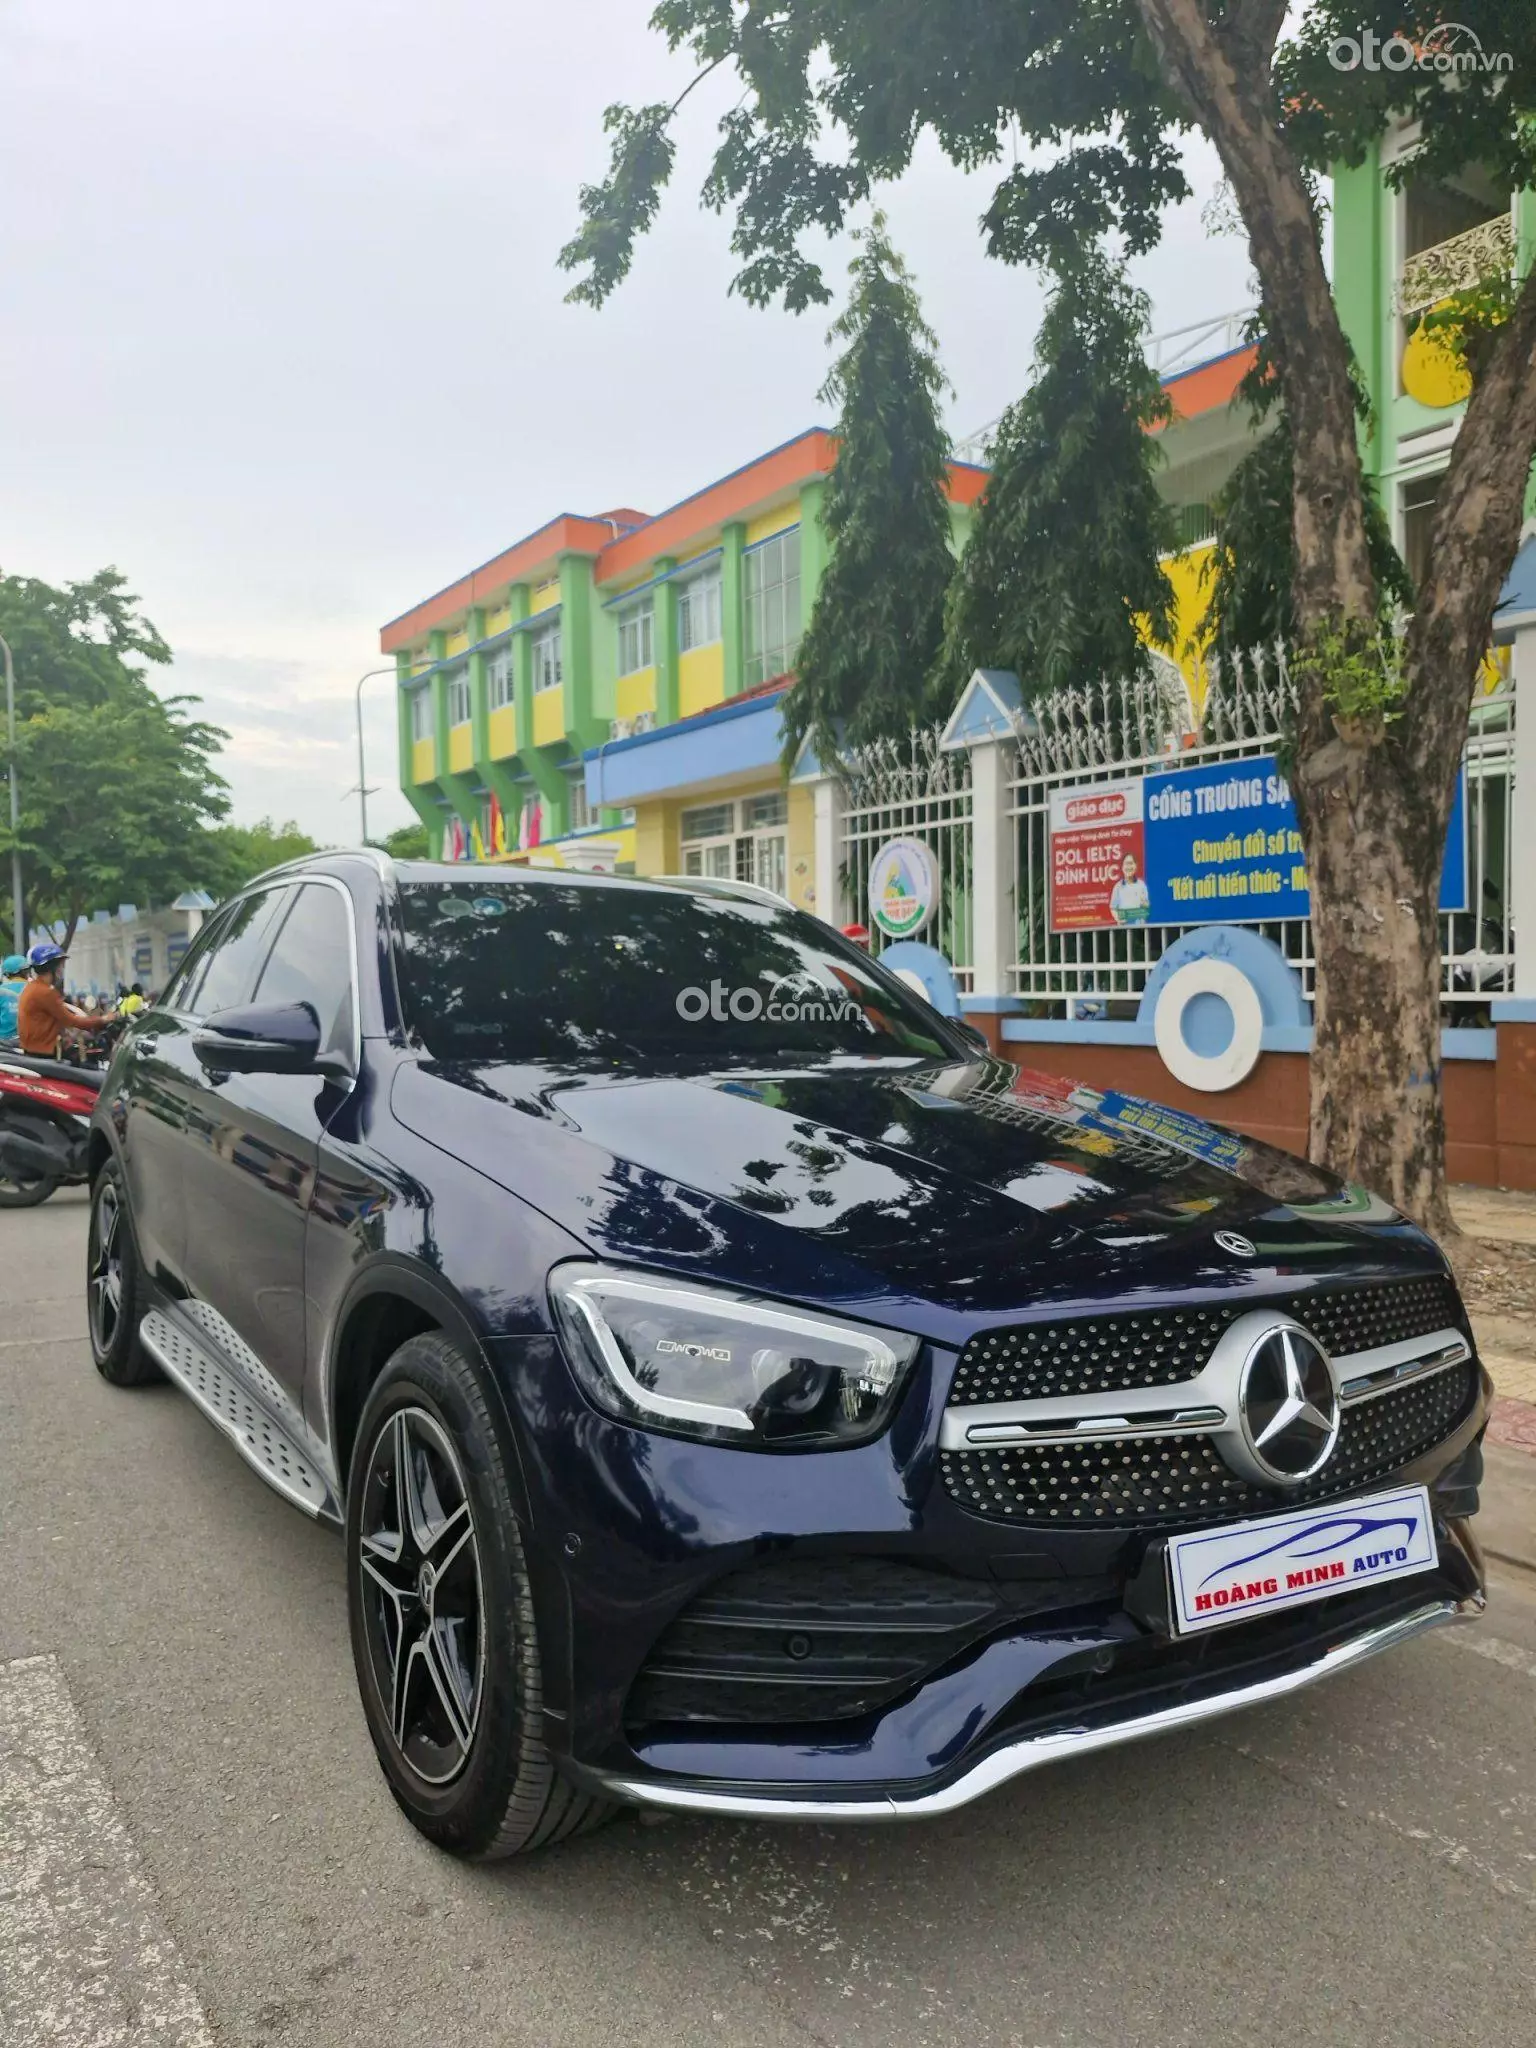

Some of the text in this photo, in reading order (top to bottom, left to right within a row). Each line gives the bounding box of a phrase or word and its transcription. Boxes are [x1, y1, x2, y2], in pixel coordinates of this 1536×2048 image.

[1194, 777, 1263, 815] TRƯỜNG
[1266, 774, 1292, 809] SẠ
[1055, 844, 1122, 866] DOL IELTS
[1194, 1546, 1409, 1612] HOÀNG MINH AUTO
